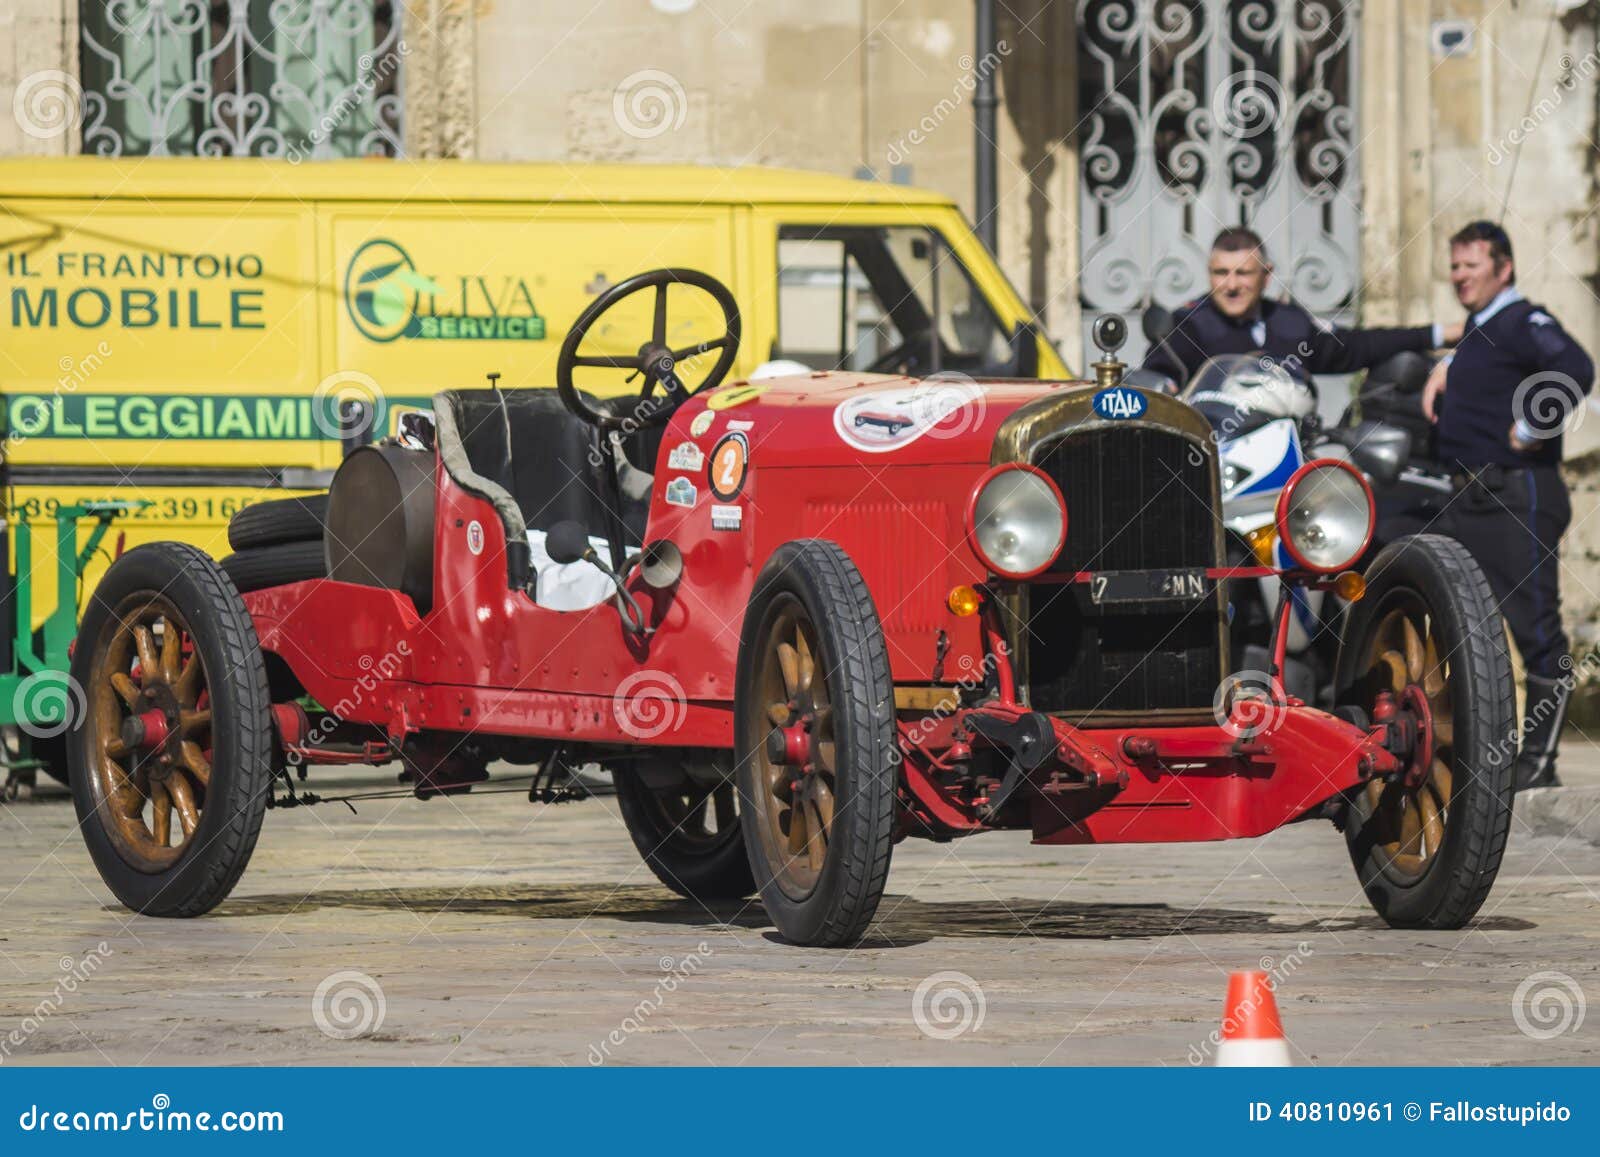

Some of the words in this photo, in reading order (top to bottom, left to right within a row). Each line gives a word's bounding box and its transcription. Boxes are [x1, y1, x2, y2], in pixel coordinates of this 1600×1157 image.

[8, 253, 40, 276] IL
[58, 253, 263, 278] FRANTOIO
[11, 288, 265, 329] MOBILE
[421, 317, 545, 338] SERVICE
[1102, 389, 1142, 418] ITALA
[722, 448, 737, 486] 2
